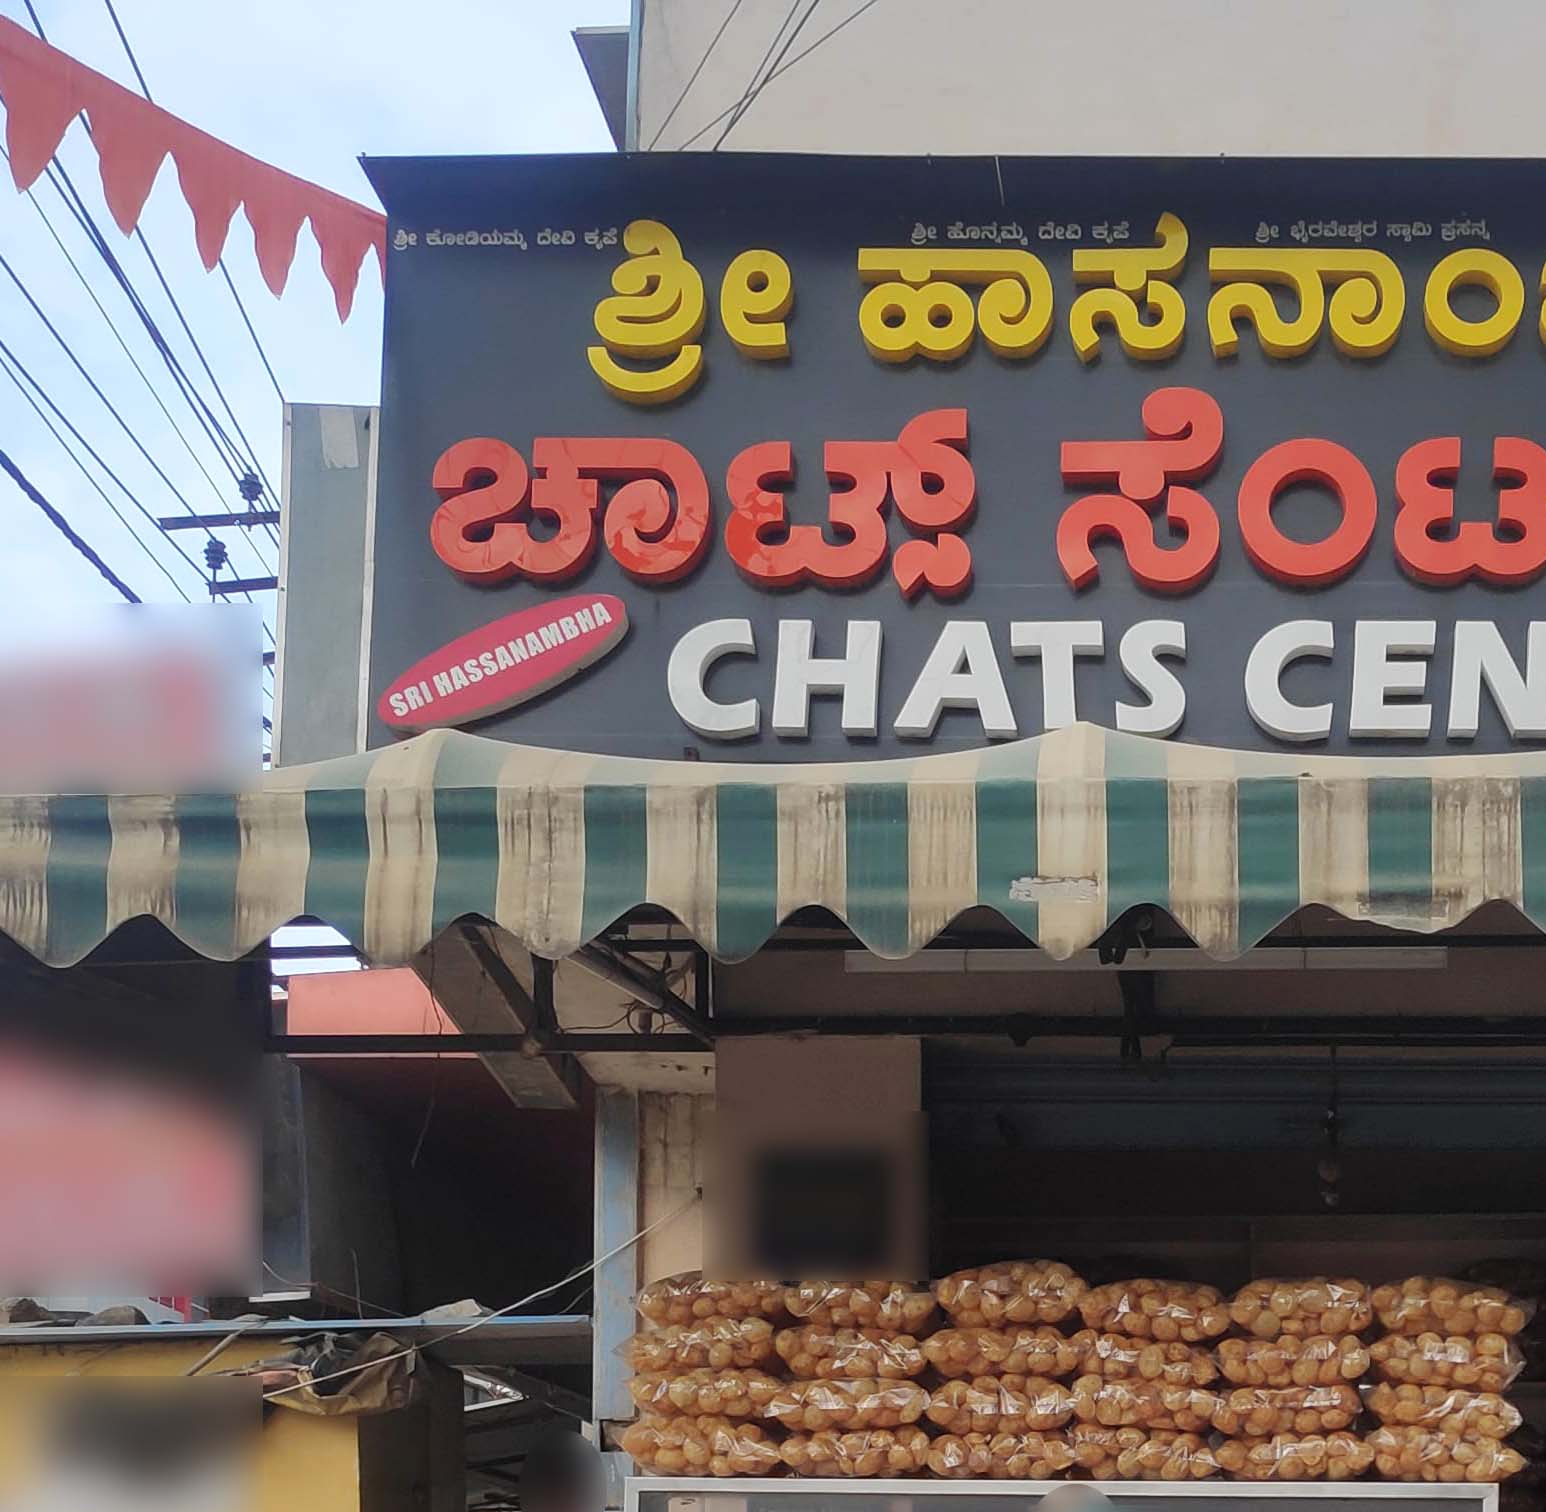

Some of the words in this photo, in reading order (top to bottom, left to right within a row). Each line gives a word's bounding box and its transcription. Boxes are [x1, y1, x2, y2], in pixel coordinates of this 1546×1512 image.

[394, 229, 417, 250] ಶ್ರೀ
[537, 228, 575, 246] ದೇವಿ
[584, 228, 618, 250] ಕೃಪೆ
[910, 222, 937, 245] ಶ್ರೀ
[1038, 222, 1082, 240] ದೇವಿ
[1092, 221, 1130, 243] ಕೃಪೆ
[1255, 221, 1279, 243] ಶ್ರೀ
[1386, 221, 1432, 242] ಸ್ವಾಮಿ
[1441, 219, 1490, 241] ಪ್ರಸನ್ನ
[587, 219, 792, 401] ಶ್ರೀ
[430, 408, 977, 600] ಚಾಟ್ಸ್
[389, 681, 434, 719] SRI
[433, 600, 614, 698] HASSANAMBHA
[667, 617, 1188, 740] CHATS
